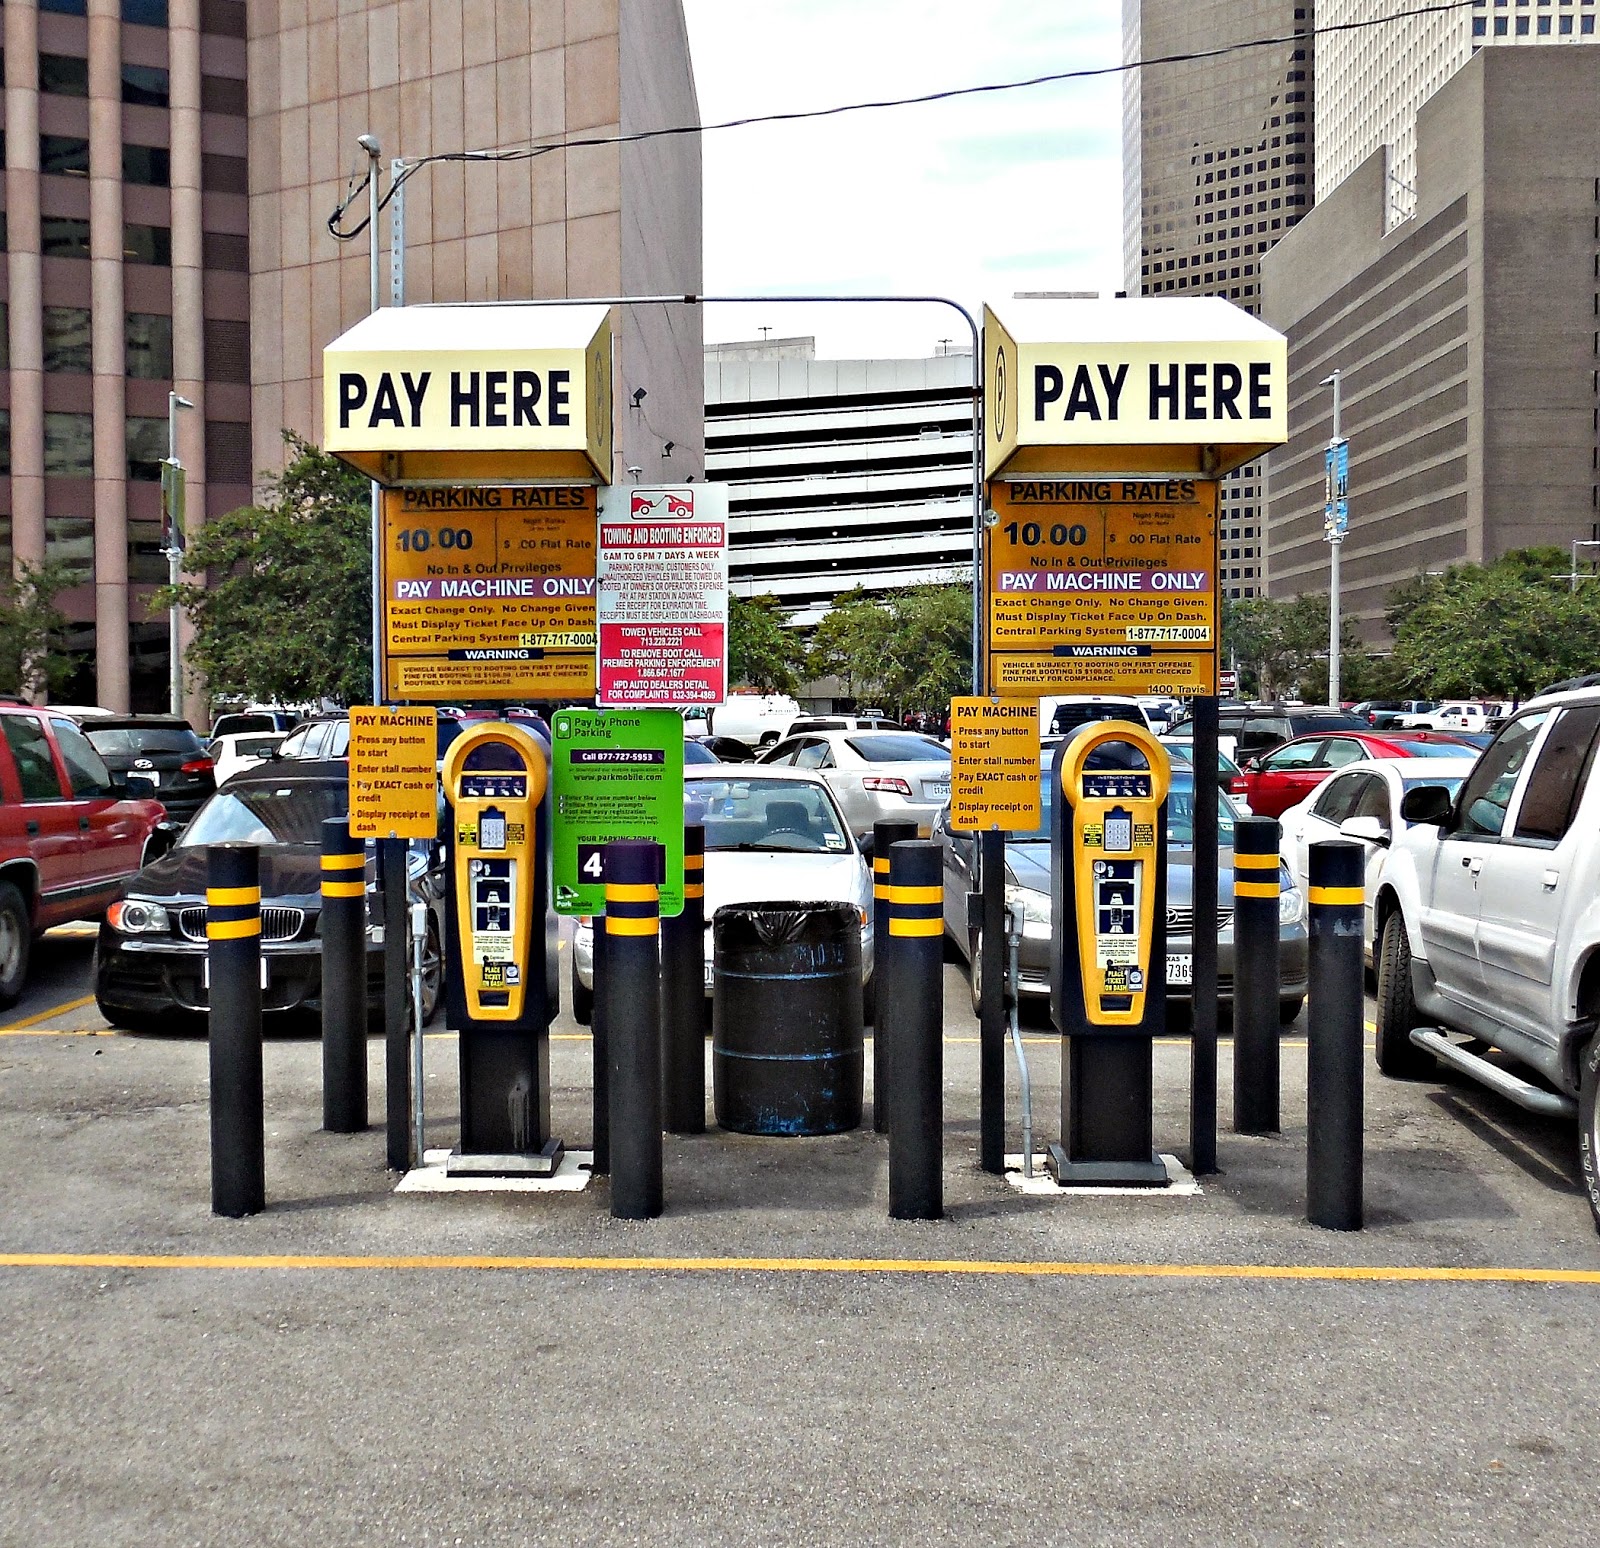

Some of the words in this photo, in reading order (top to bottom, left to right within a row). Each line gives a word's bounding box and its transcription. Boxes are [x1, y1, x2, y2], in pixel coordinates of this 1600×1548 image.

[1034, 363, 1130, 421] PAY
[1149, 362, 1271, 420] HERE
[339, 372, 432, 428] PAY
[450, 370, 570, 427] HERE
[1010, 482, 1111, 500] PARKING
[1121, 482, 1195, 500] RATES
[404, 487, 500, 507] PARKING
[512, 487, 585, 506] RATES
[603, 528, 631, 545] TOWING
[633, 527, 648, 544] AND
[649, 527, 682, 544] BOOTING
[683, 526, 722, 544] ENFORCED
[1003, 521, 1087, 546] 10.00
[1150, 534, 1170, 544] Flat
[1175, 534, 1201, 544] Rate
[624, 552, 635, 560] TO
[657, 551, 662, 560] 7
[664, 551, 686, 559] DAYS
[687, 551, 693, 559] A
[695, 551, 720, 559] WEEK
[608, 563, 632, 571] PARKING
[633, 563, 644, 571] FOR
[645, 563, 664, 571] PAYING
[666, 563, 699, 571] CUSTOMERS
[1030, 556, 1047, 567] No
[1051, 556, 1063, 567] In
[1066, 556, 1075, 567] &
[1079, 556, 1103, 567] Out
[1106, 556, 1168, 569] Privileges
[427, 565, 444, 574] No
[447, 565, 459, 574] In
[462, 565, 471, 574] &
[475, 563, 498, 573] Out
[501, 562, 562, 574] Privileges
[1001, 573, 1038, 590] PAY
[1046, 573, 1142, 590] MACHINE
[1151, 573, 1205, 590] ONLY
[397, 581, 432, 598] PAY
[441, 579, 533, 597] MACHINE
[542, 578, 595, 596] ONLY
[995, 598, 1027, 607] Exact
[1030, 598, 1071, 608] Change
[1075, 598, 1103, 608] Only.
[1109, 598, 1124, 607] No
[1127, 598, 1170, 608] Change
[1173, 598, 1207, 607] Given.
[391, 606, 422, 615] Exact
[425, 606, 464, 616] Change
[469, 605, 495, 615] Only.
[502, 605, 516, 613] No
[520, 604, 561, 614] Change
[995, 612, 1023, 621] Must
[1026, 612, 1066, 622] Display
[1070, 612, 1104, 621] Ticket
[1108, 612, 1135, 621] Face
[1138, 612, 1153, 622] Up
[1157, 612, 1172, 621] On
[1176, 612, 1206, 621] Dash.
[392, 620, 418, 629] Must
[421, 620, 460, 630] Display
[463, 619, 498, 628] Ticket
[501, 619, 527, 627] Face
[531, 618, 545, 628] Up
[549, 618, 564, 626] On
[621, 627, 646, 636] TOWED
[648, 627, 682, 636] VEHICLES
[683, 627, 702, 636] CALL
[995, 627, 1036, 635] Central
[1039, 627, 1082, 637] Parking
[1085, 627, 1126, 637] System
[1128, 628, 1207, 640] 1-877-717-0004
[392, 634, 431, 643] Central
[434, 633, 475, 644] Parking
[479, 633, 519, 643] System
[521, 633, 598, 645] 1-877-717-0004
[465, 649, 529, 659] WARNING
[620, 649, 630, 658] TO
[631, 649, 661, 658] REMOVE
[662, 649, 682, 658] BOOT
[684, 649, 702, 658] CALL
[1072, 646, 1138, 656] WARNING
[602, 658, 633, 668] PREMIER
[635, 658, 666, 668] PARKING
[667, 658, 721, 668] ENFORCEMENT
[613, 680, 628, 689] HPD
[628, 680, 649, 689] AUTO
[650, 680, 684, 689] DEALERS
[684, 680, 709, 689] DETAIL
[1148, 685, 1173, 694] 1400
[1176, 685, 1205, 694] Travis
[607, 690, 621, 699] FOR
[622, 690, 669, 699] COMPLAINTS
[957, 707, 979, 717] PAY
[982, 707, 1037, 717] MACHINE
[355, 715, 376, 726] PAY
[380, 715, 433, 726] MACHINE
[574, 718, 591, 728] Pay
[595, 718, 607, 728] by
[609, 718, 640, 727] Phone
[574, 728, 612, 738] Parking
[958, 727, 982, 735] Press
[984, 729, 999, 737] any
[1001, 727, 1028, 735] button
[958, 741, 968, 749] to
[969, 741, 990, 749] start
[958, 757, 981, 765] Enter
[983, 757, 1002, 765] stall
[1004, 757, 1036, 765] number
[573, 773, 662, 782] www.parkmobile.com
[958, 773, 974, 782] Pay
[976, 773, 1004, 781] EXACT
[1006, 773, 1026, 781] cash
[958, 786, 984, 794] credit
[958, 803, 989, 812] Display
[991, 803, 1021, 812] receipt
[958, 816, 978, 824] dash
